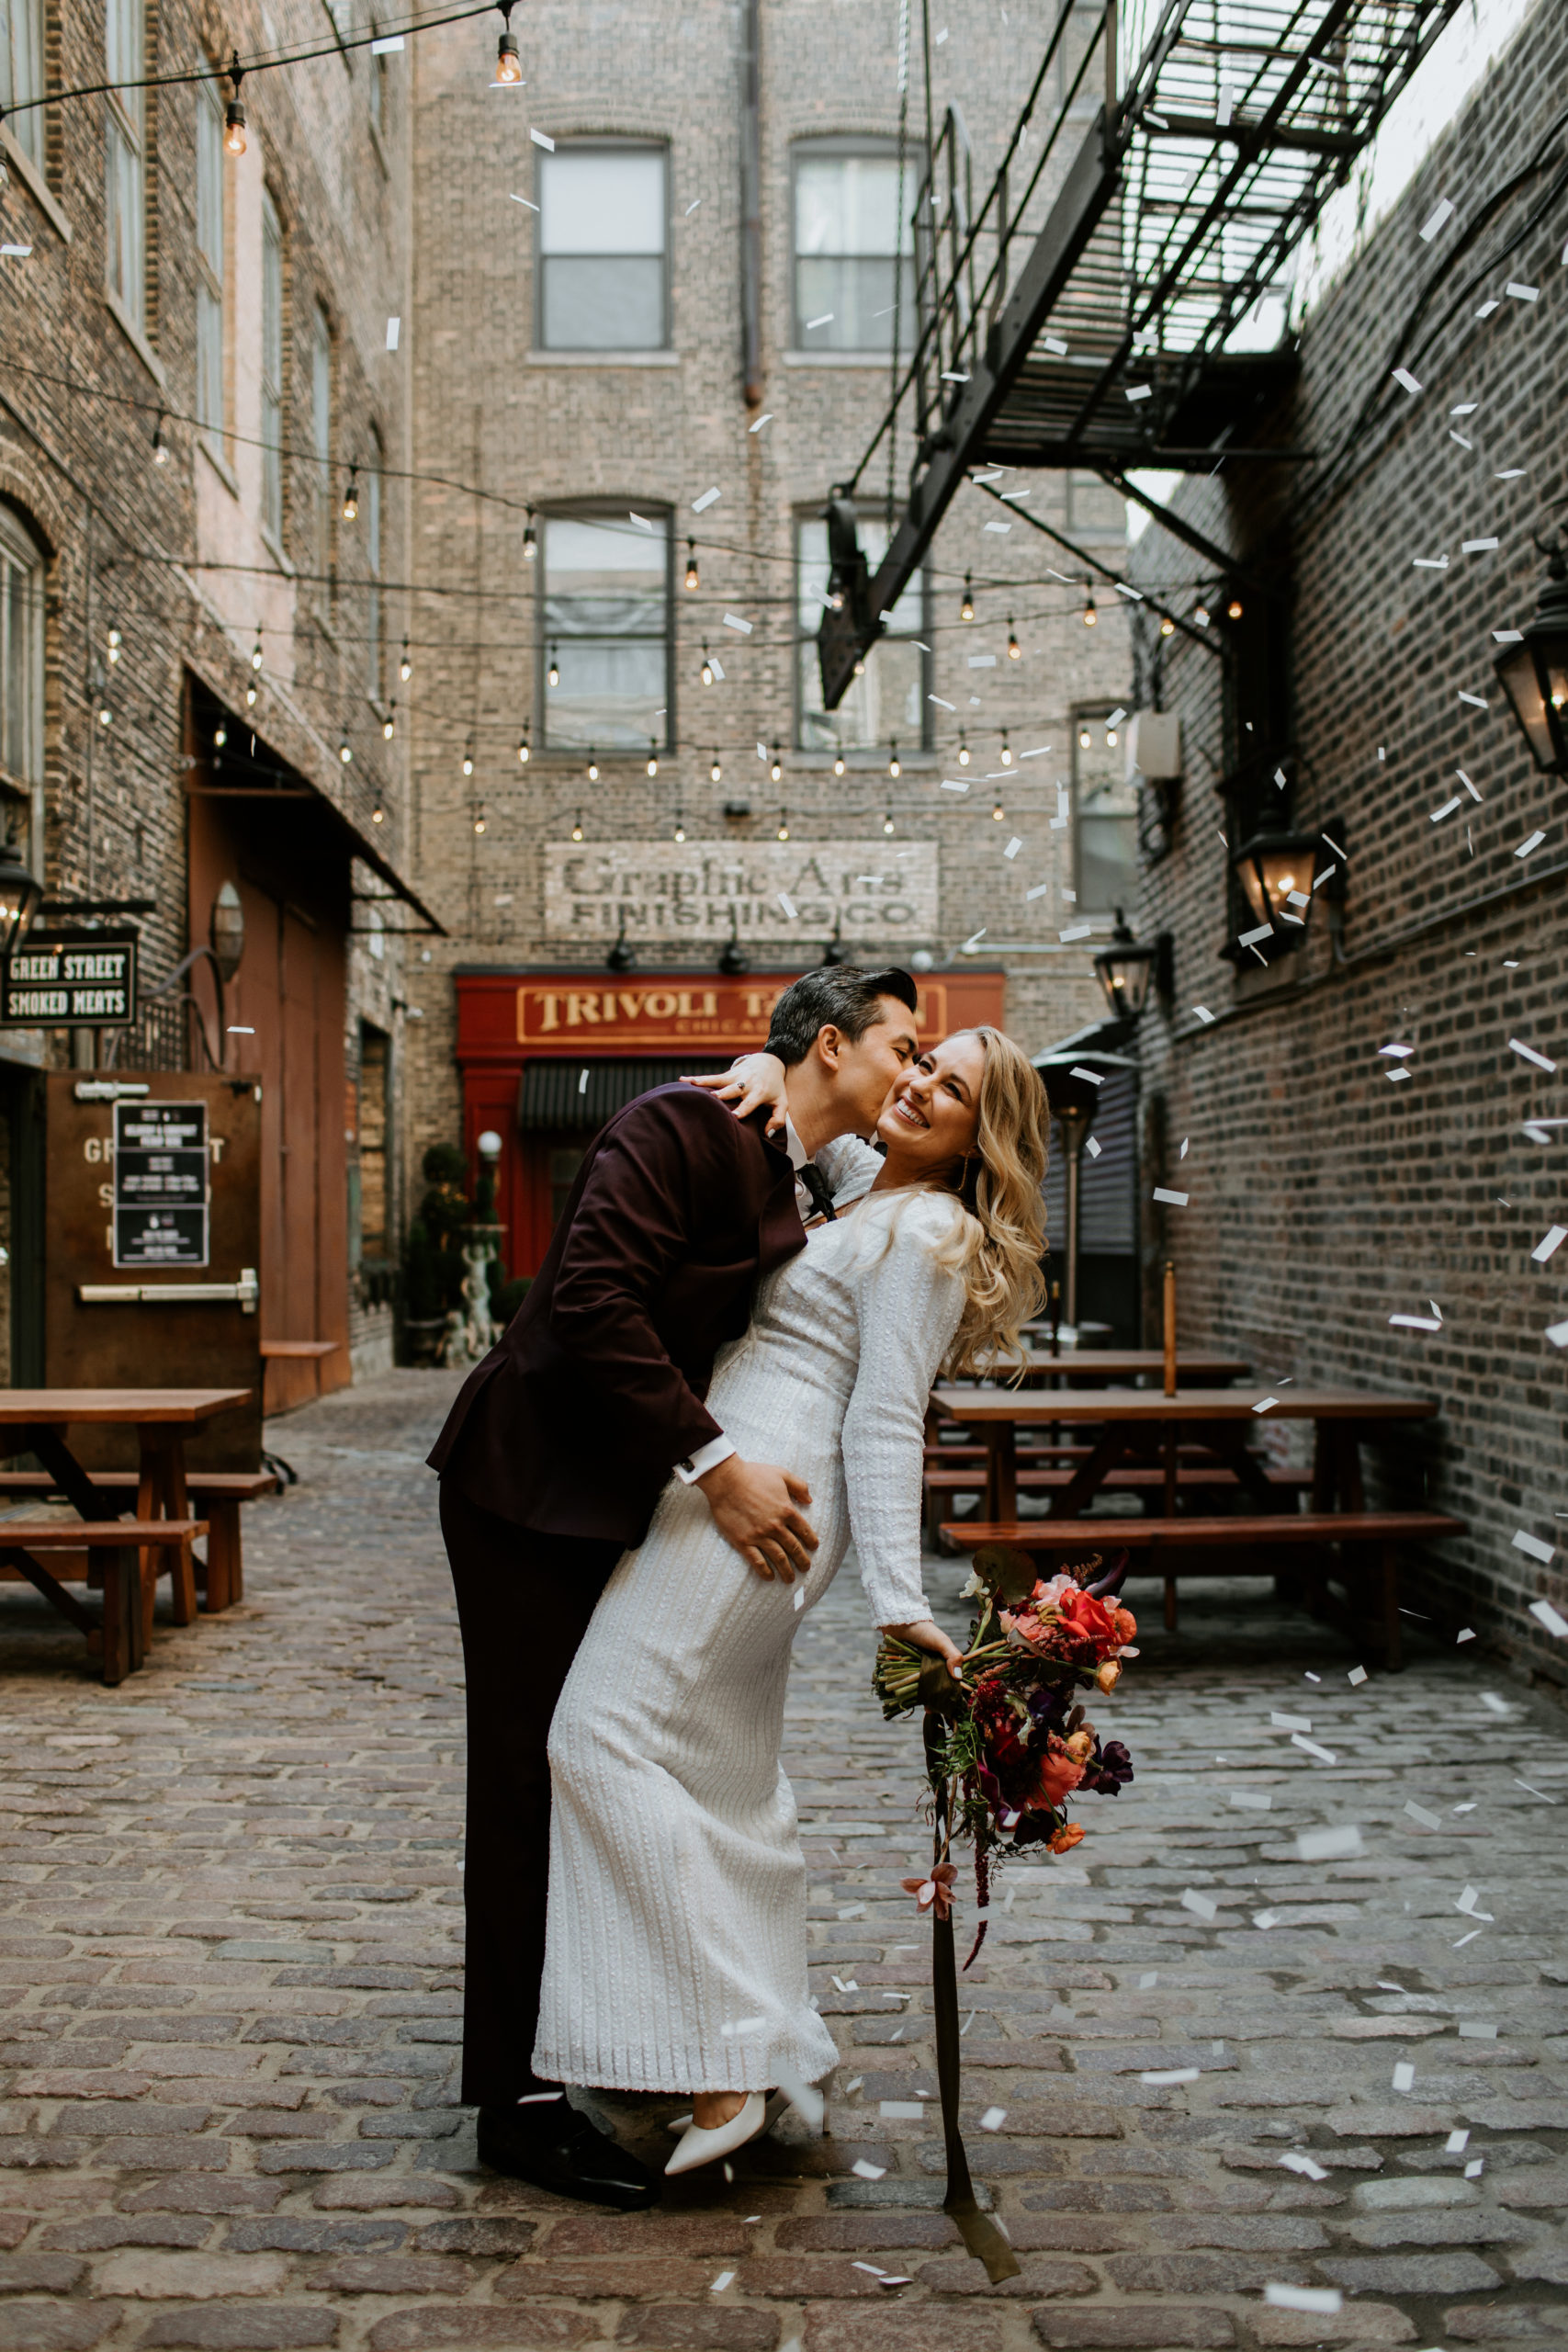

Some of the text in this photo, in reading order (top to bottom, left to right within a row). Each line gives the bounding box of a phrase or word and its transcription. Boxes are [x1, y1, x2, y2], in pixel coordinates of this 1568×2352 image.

[563, 856, 902, 901] Graphic Arts
[570, 902, 830, 925] FINISHING
[10, 954, 126, 980] GREEN STREET
[8, 989, 125, 1016] SMOKED MEATS
[534, 991, 718, 1033] TRIVOLI
[675, 1018, 771, 1035] CHICAG
